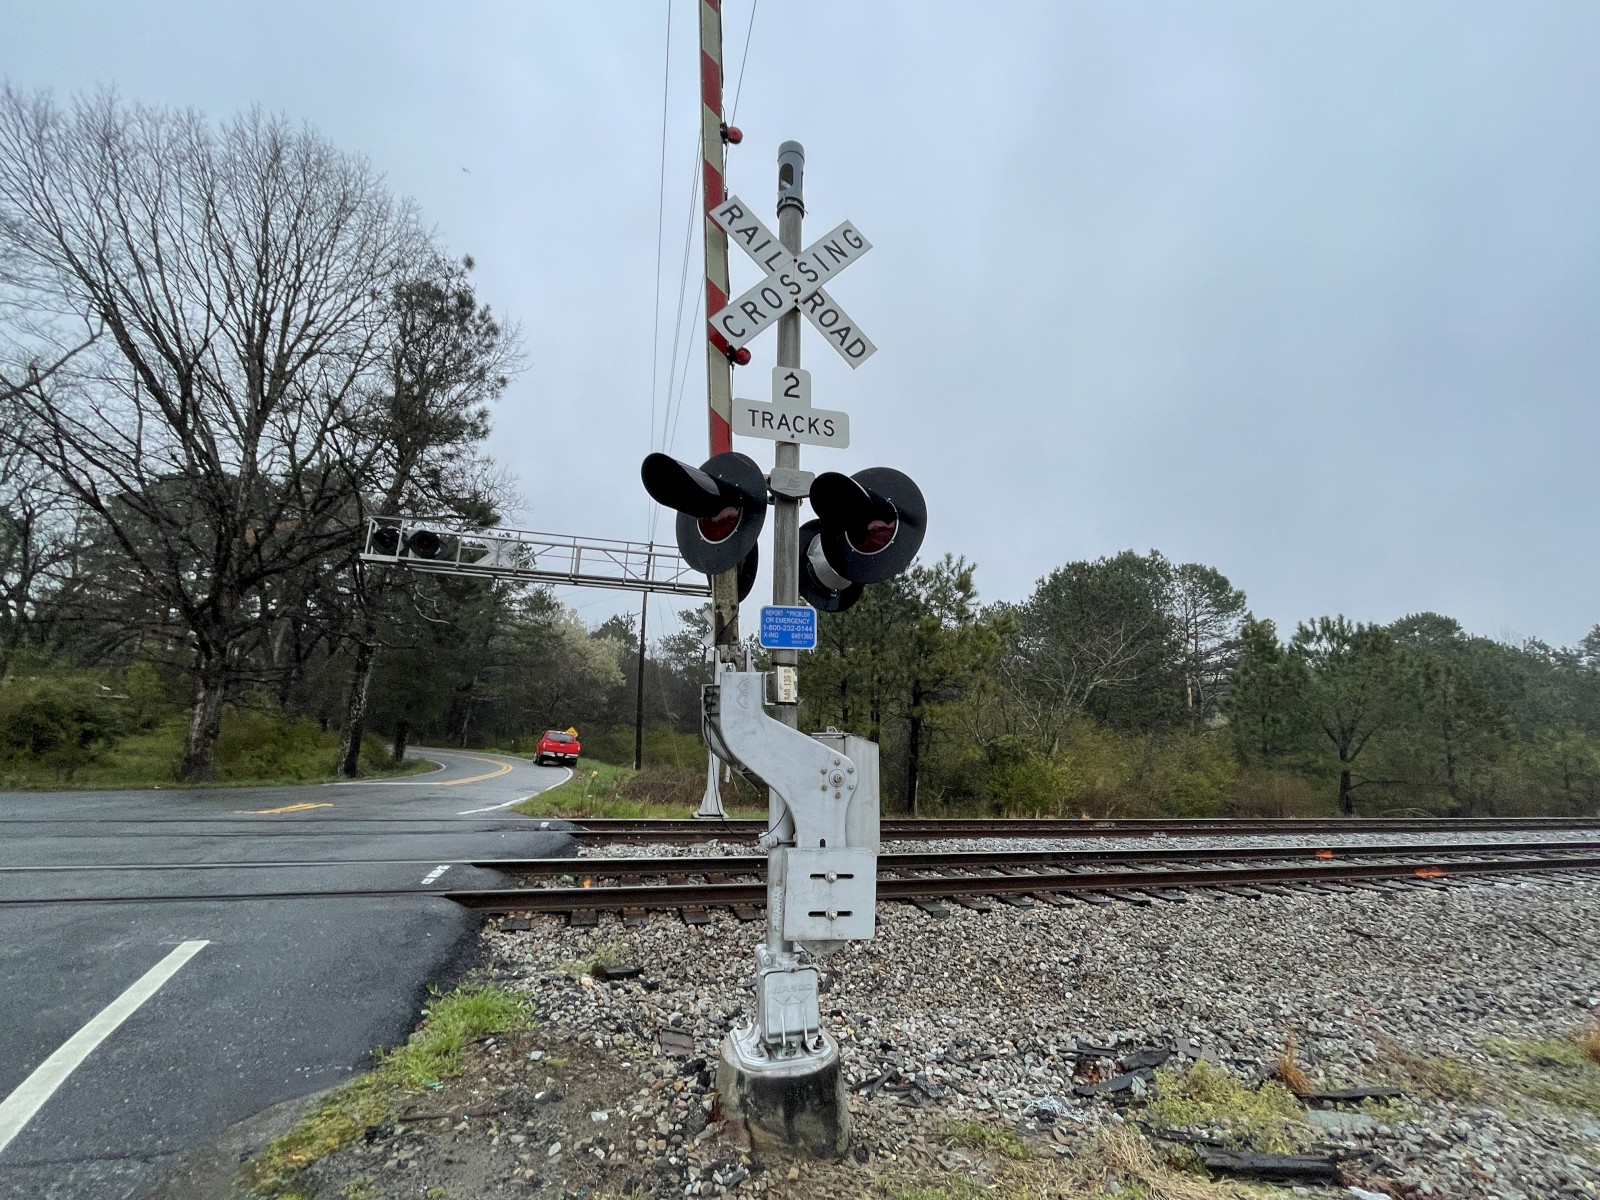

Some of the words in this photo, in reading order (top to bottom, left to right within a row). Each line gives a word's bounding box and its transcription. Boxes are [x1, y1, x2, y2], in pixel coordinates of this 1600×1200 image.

[719, 203, 782, 272] RAIL
[722, 228, 863, 338] CROSSING
[801, 289, 867, 358] ROAD
[783, 372, 800, 399] 2
[747, 408, 835, 437] TRACKS
[765, 609, 783, 617] REPORT
[789, 610, 811, 618] PROBLEM
[775, 617, 810, 625] EMERGENCY
[763, 624, 813, 632] 1-800-232-0144
[763, 631, 779, 639] X-ING
